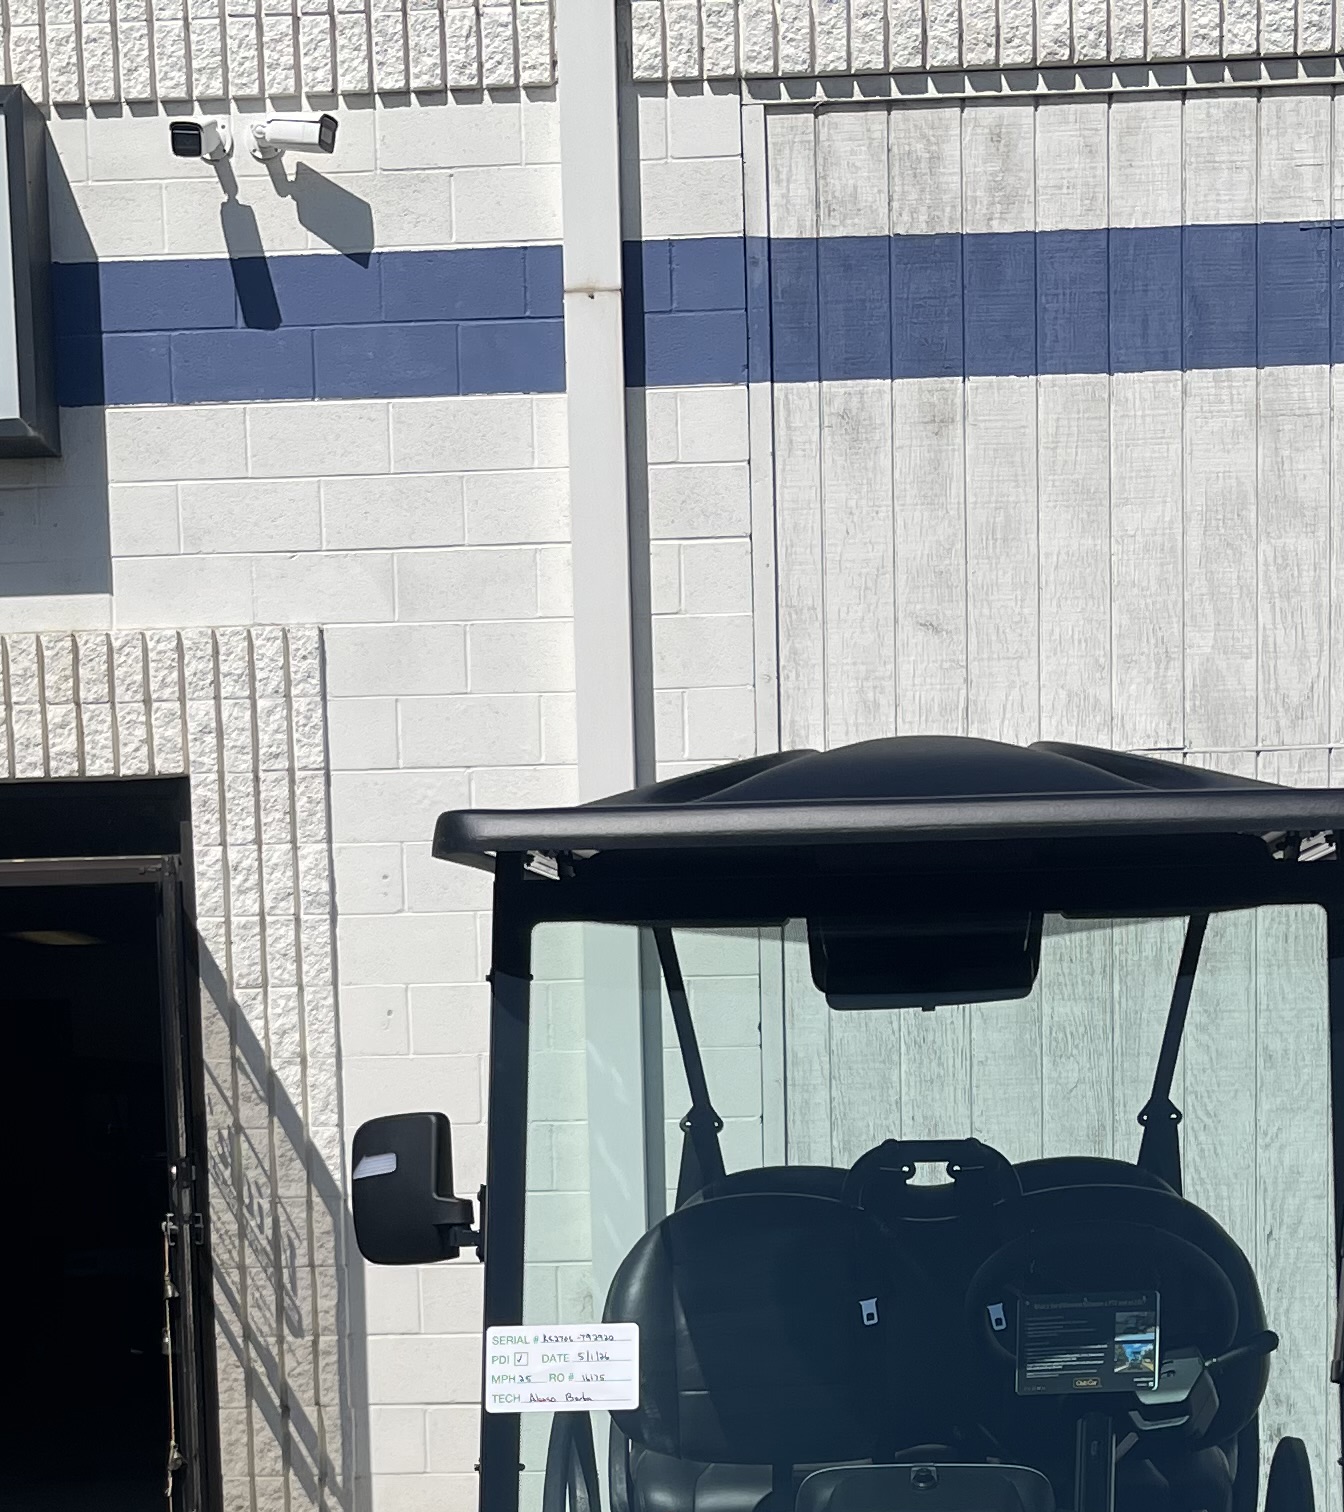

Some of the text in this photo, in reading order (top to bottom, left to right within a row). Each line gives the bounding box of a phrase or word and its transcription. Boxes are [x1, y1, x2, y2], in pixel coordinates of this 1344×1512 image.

[491, 1335, 530, 1346] SERIAL
[533, 1335, 540, 1345] #
[491, 1355, 510, 1365] PDI
[541, 1353, 570, 1364] DATE
[491, 1374, 516, 1385] MPH
[518, 1374, 532, 1383] 25
[548, 1372, 565, 1383] RO
[568, 1372, 575, 1382] #
[492, 1393, 521, 1404] TECH
